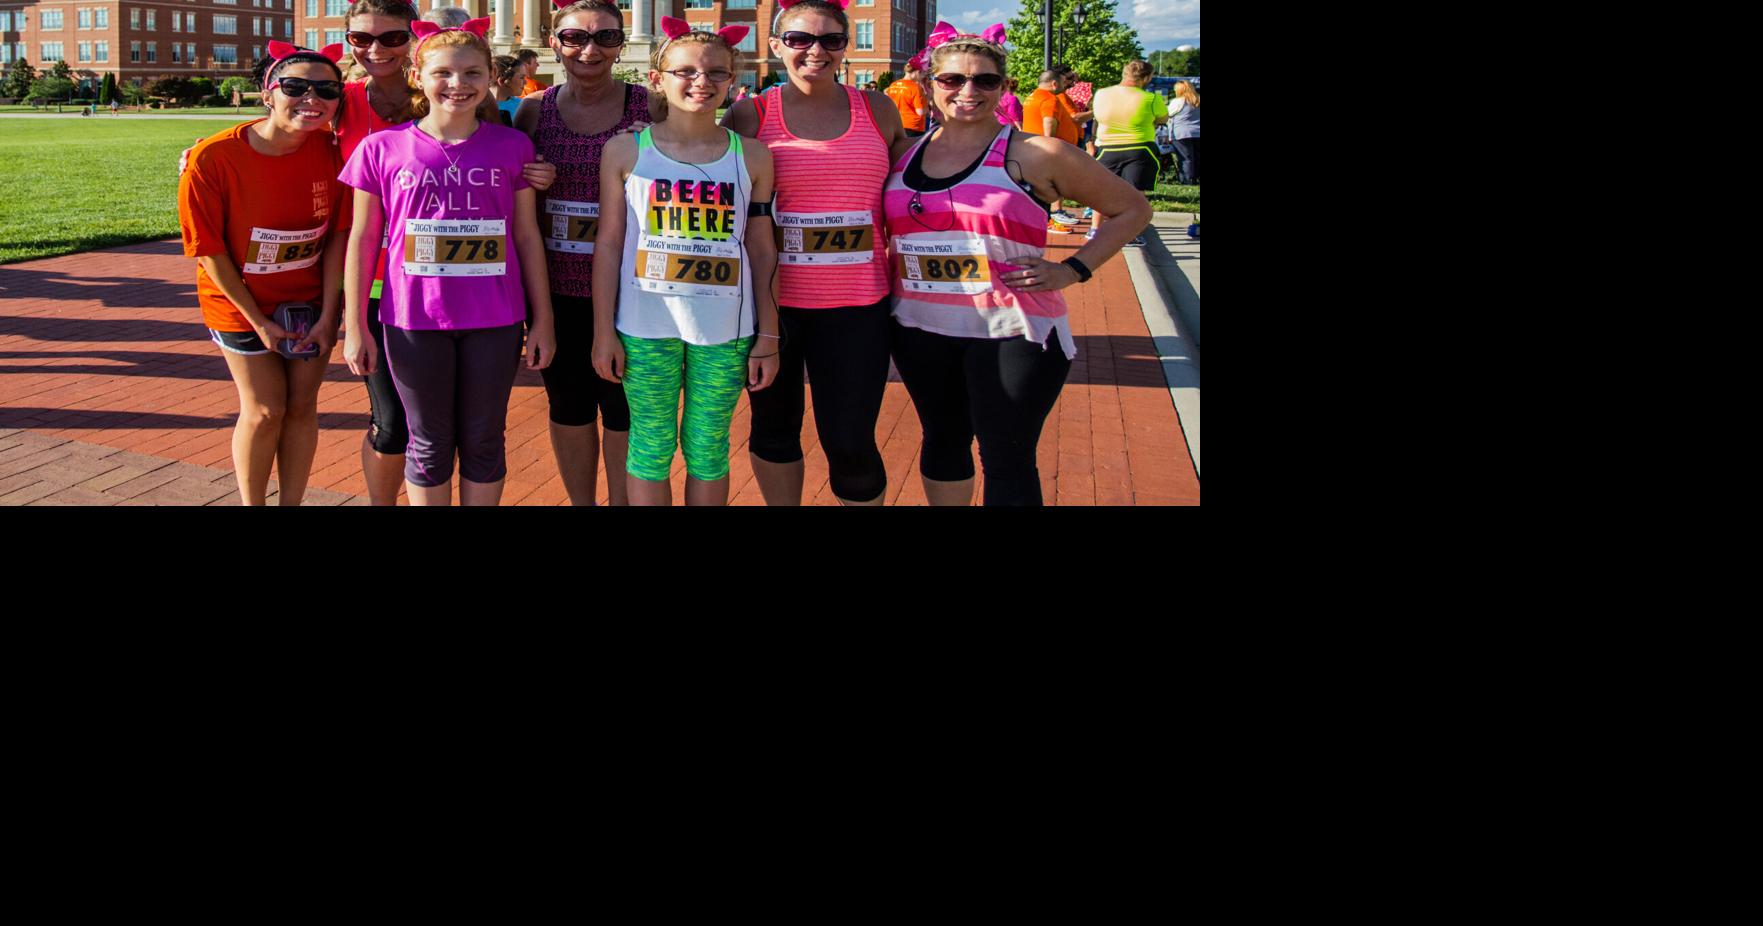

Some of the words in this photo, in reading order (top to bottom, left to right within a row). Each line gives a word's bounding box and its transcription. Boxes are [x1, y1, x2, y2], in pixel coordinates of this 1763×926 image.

[399, 167, 501, 190] DANCE
[425, 191, 480, 211] ALL
[655, 178, 735, 206] BEEN
[414, 224, 432, 233] JIGGY
[433, 225, 447, 233] WITH
[448, 225, 459, 233] THE
[460, 224, 479, 233] PIGGY
[653, 206, 736, 233] THERE
[782, 215, 799, 225] JIGGY
[800, 217, 813, 225] WITH
[814, 217, 824, 225] THE
[825, 215, 844, 225] PIGGY
[260, 233, 279, 241] JIGGY
[647, 240, 666, 249] JIGGY
[667, 243, 681, 252] WITH
[682, 244, 692, 252] THE
[693, 244, 713, 254] PIGGY
[812, 229, 865, 251] 747
[445, 240, 498, 260] 778
[935, 245, 953, 253] PIGGY
[674, 258, 731, 282] 780
[927, 258, 981, 279] 802
